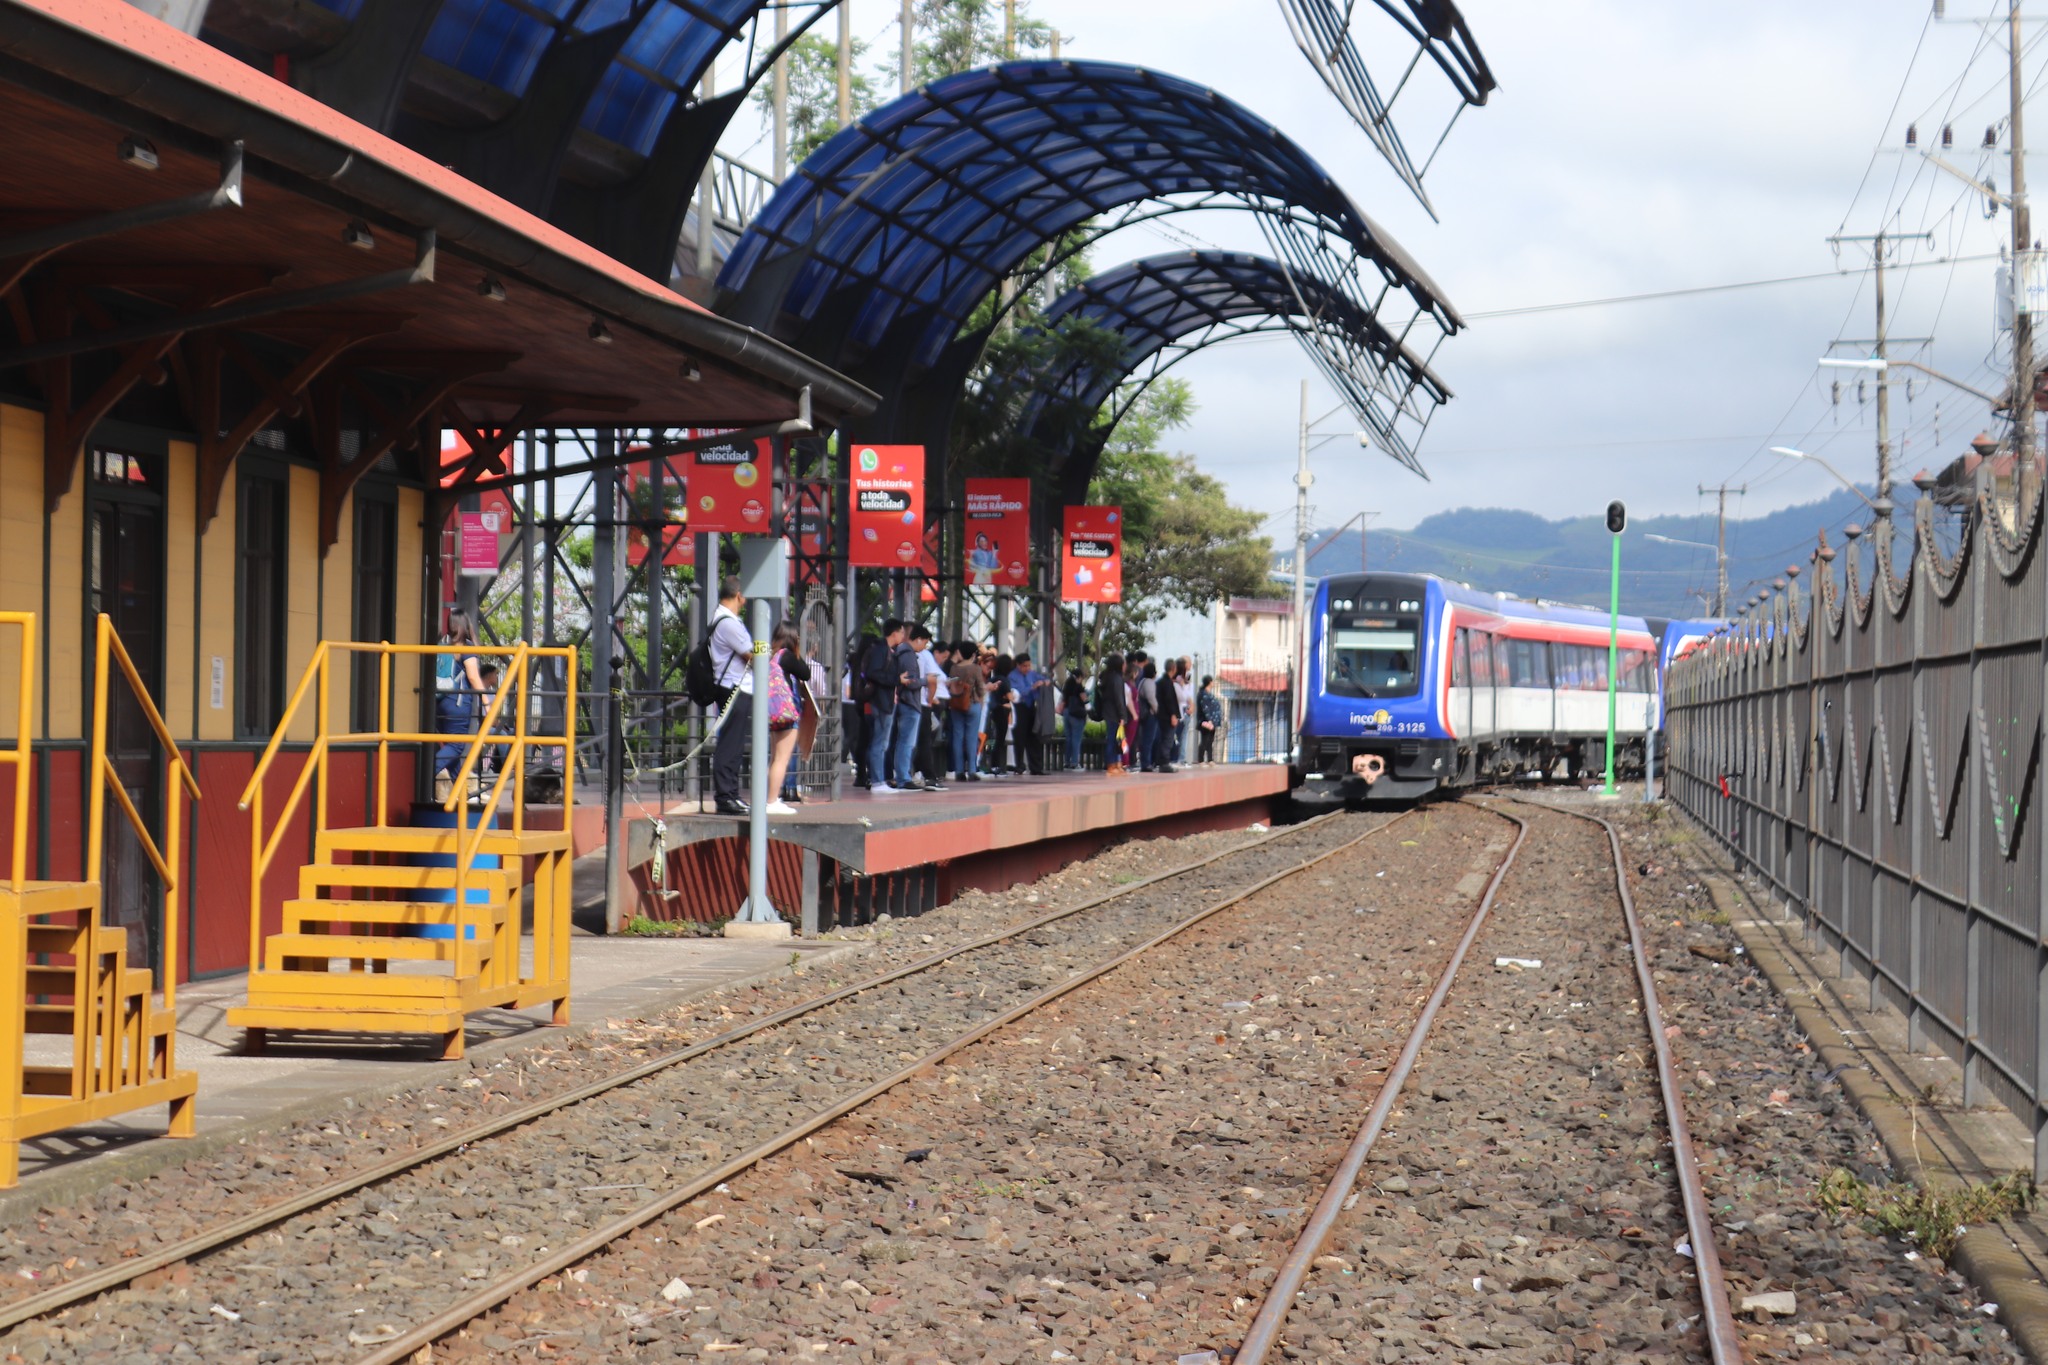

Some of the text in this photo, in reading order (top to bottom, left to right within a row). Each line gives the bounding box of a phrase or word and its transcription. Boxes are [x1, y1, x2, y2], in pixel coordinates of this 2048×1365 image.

[700, 450, 749, 461] velocidad
[856, 479, 913, 488] Tus historias
[861, 491, 889, 500] a toda
[861, 500, 904, 510] velocidad
[967, 500, 1022, 511] MÁS RÁPIDO
[742, 506, 762, 515] Claro
